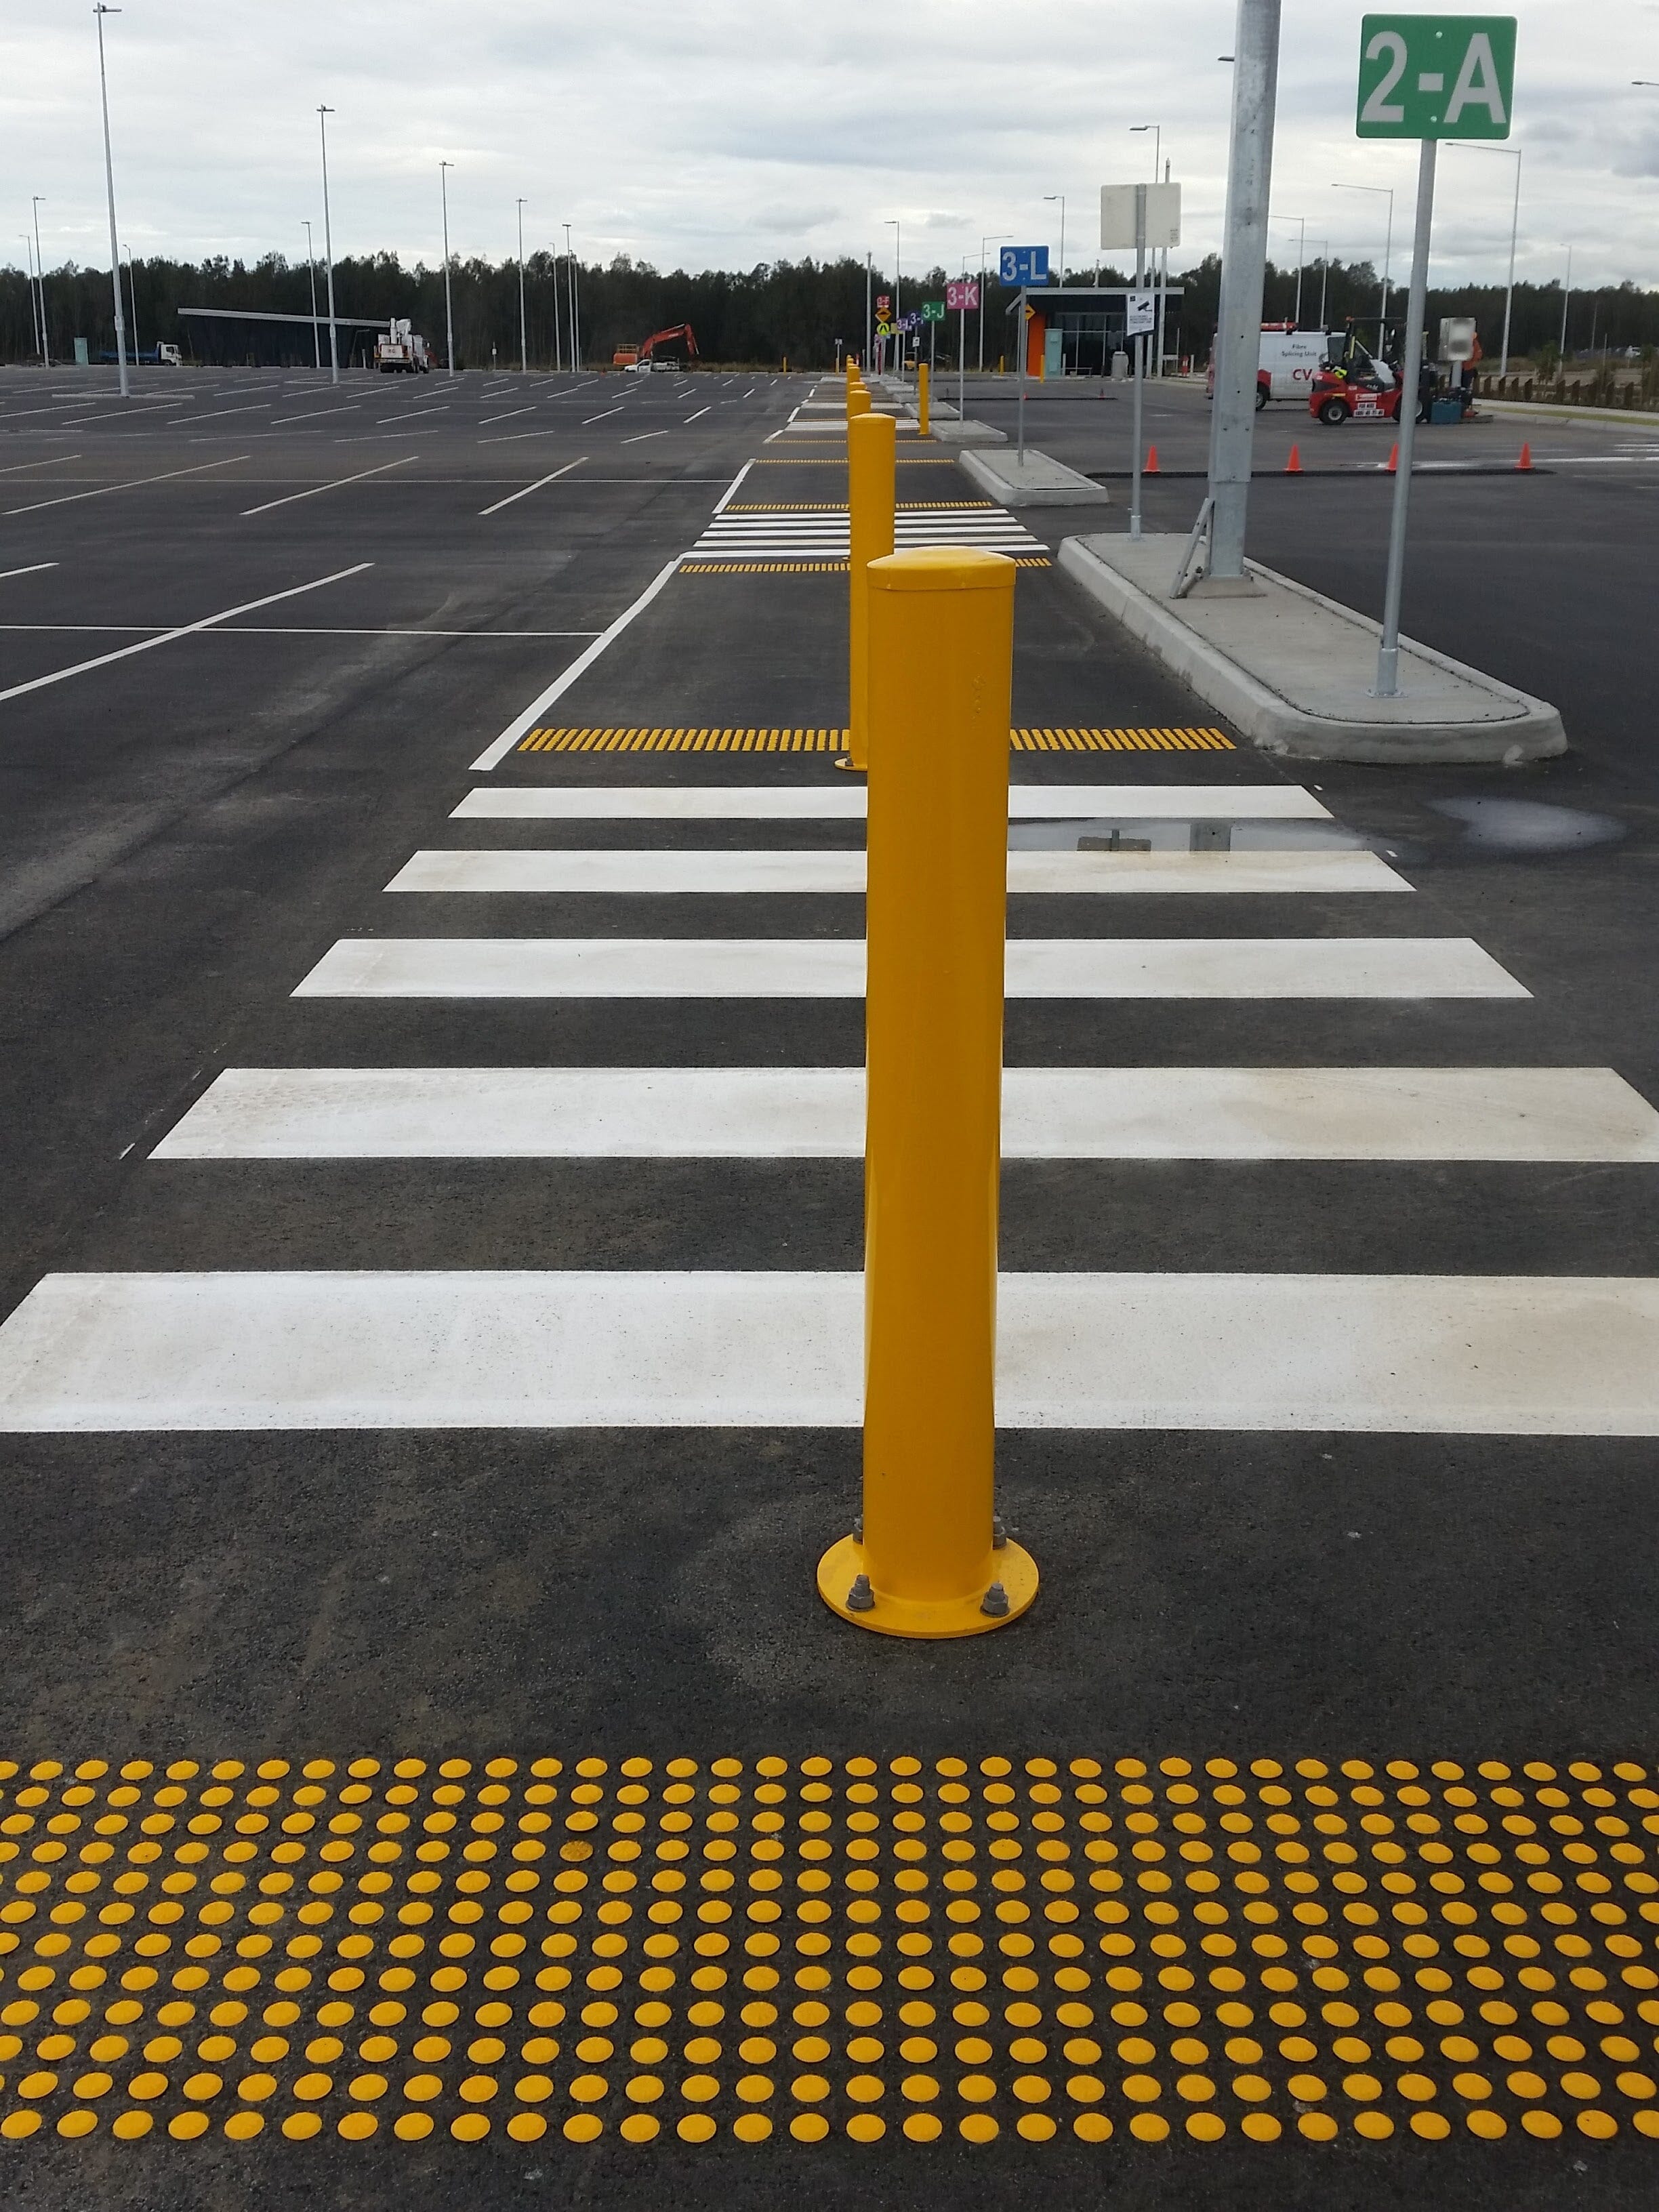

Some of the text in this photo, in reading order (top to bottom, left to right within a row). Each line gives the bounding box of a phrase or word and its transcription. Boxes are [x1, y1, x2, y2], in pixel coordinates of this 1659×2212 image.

[1360, 30, 1507, 123] 2-A
[1002, 251, 1047, 281] 3-L
[948, 286, 977, 306] 3-K
[923, 304, 944, 319] 3-J
